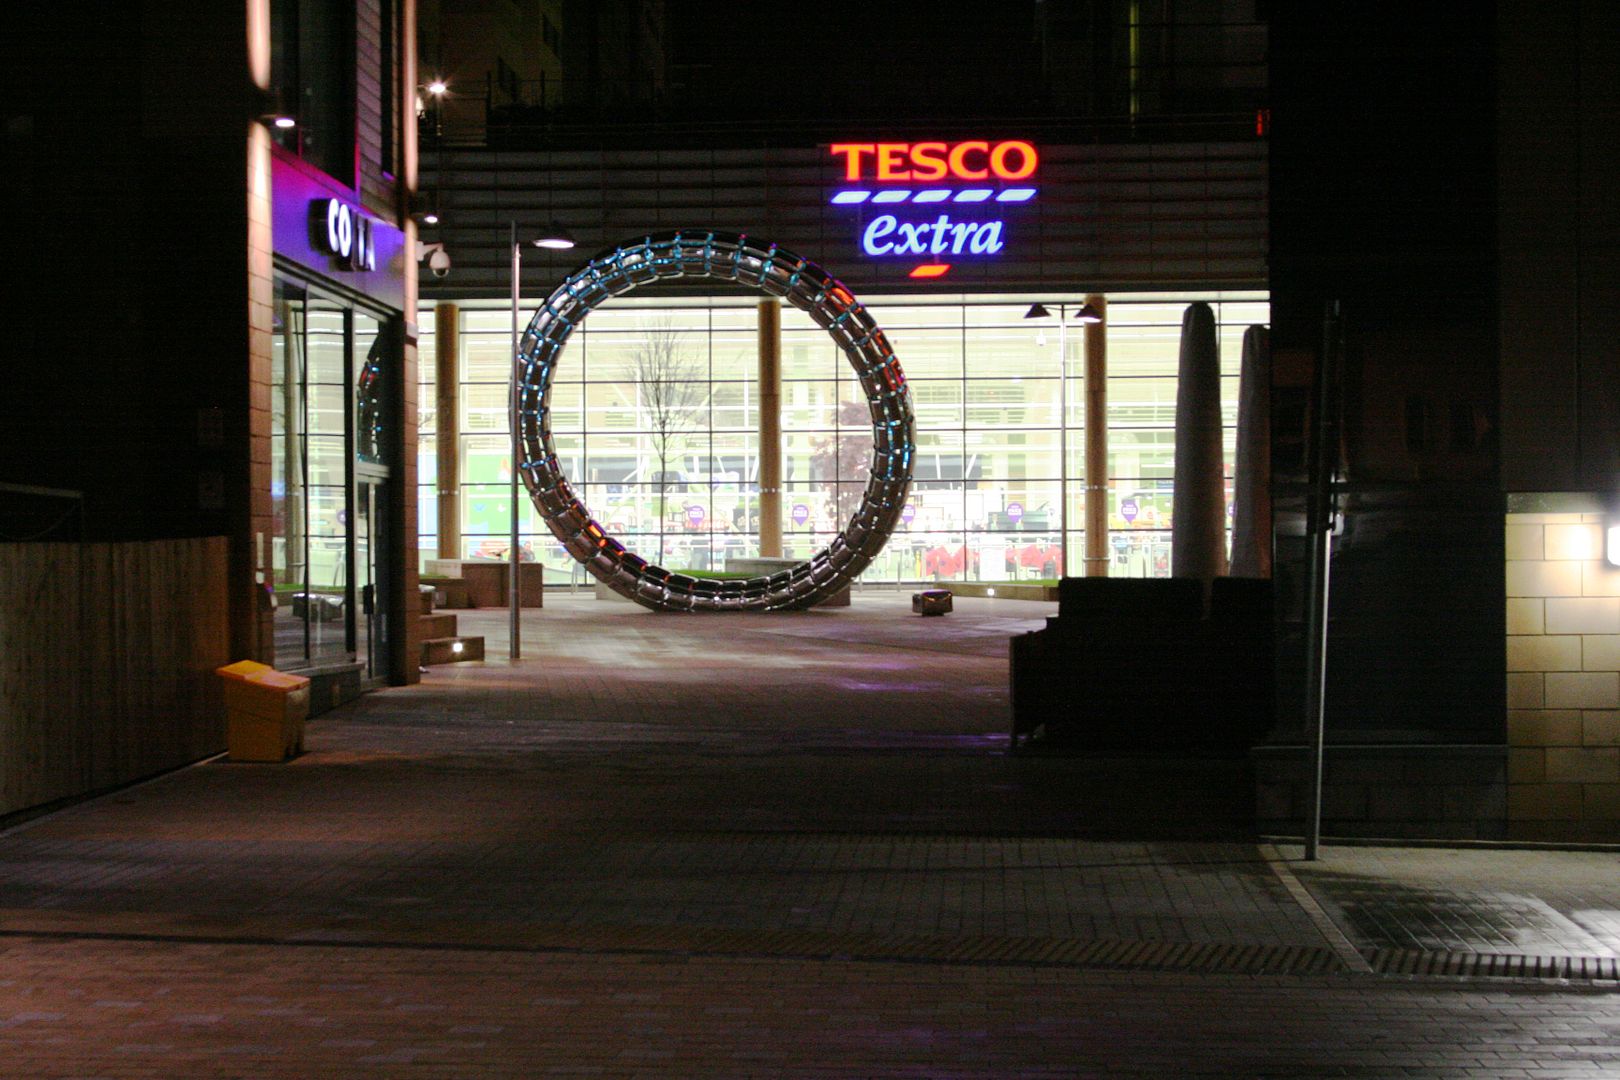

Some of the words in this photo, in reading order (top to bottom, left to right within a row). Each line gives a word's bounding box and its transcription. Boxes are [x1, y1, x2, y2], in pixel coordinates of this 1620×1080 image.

[830, 140, 1038, 181] TESCO
[327, 197, 377, 272] COTA
[862, 214, 1004, 256] extra
